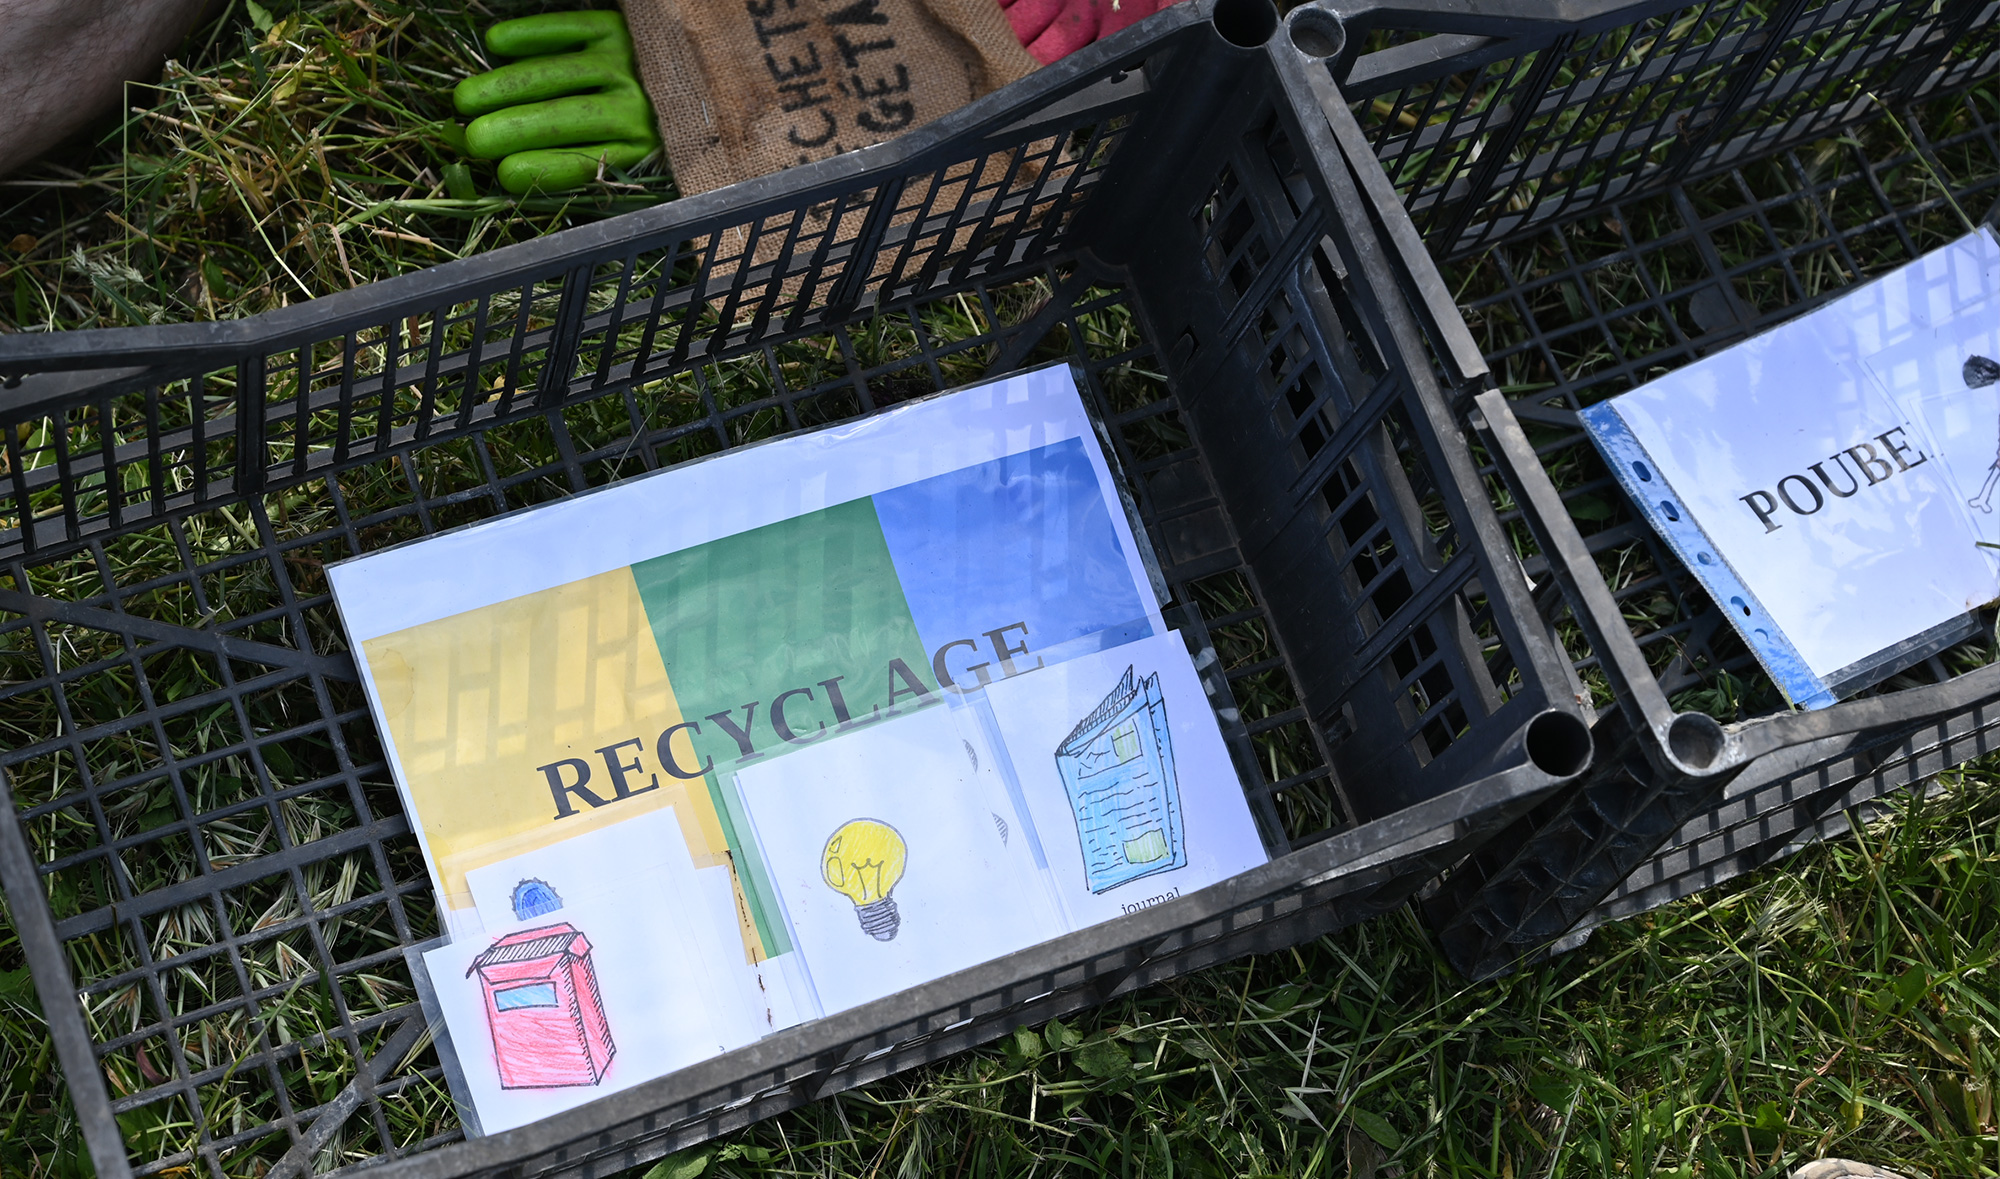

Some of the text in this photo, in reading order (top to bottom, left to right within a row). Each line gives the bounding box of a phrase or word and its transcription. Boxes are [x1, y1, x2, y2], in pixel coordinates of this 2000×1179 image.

[748, 0, 838, 172] CHETS
[824, 0, 914, 150] GÉTA
[1739, 421, 1931, 535] POUBE
[536, 621, 1044, 821] RECYCLAGE
[1121, 886, 1181, 916] journal
